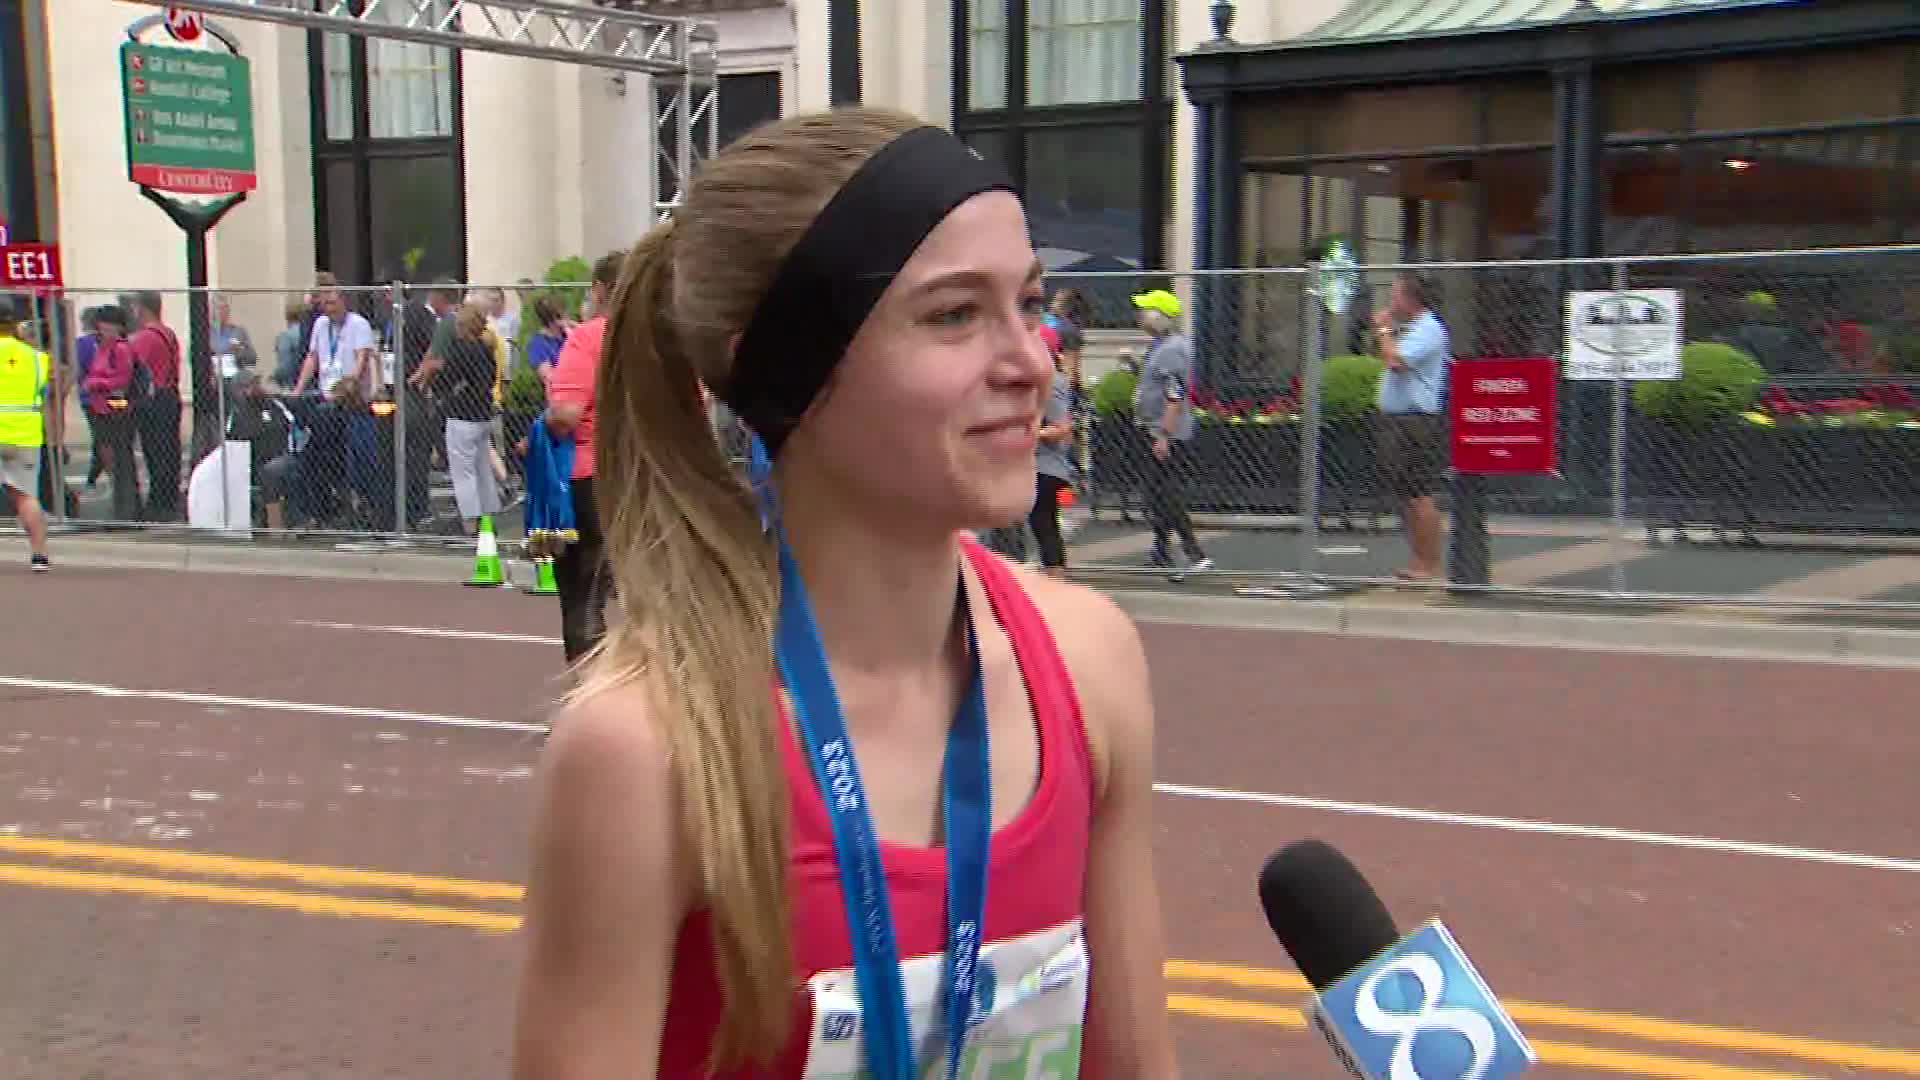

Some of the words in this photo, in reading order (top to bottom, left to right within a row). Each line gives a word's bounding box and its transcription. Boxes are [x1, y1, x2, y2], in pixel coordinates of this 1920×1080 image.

[7, 251, 54, 279] EE1
[821, 737, 860, 811] 2023
[954, 920, 977, 993] 2023
[1355, 952, 1498, 1080] 8
